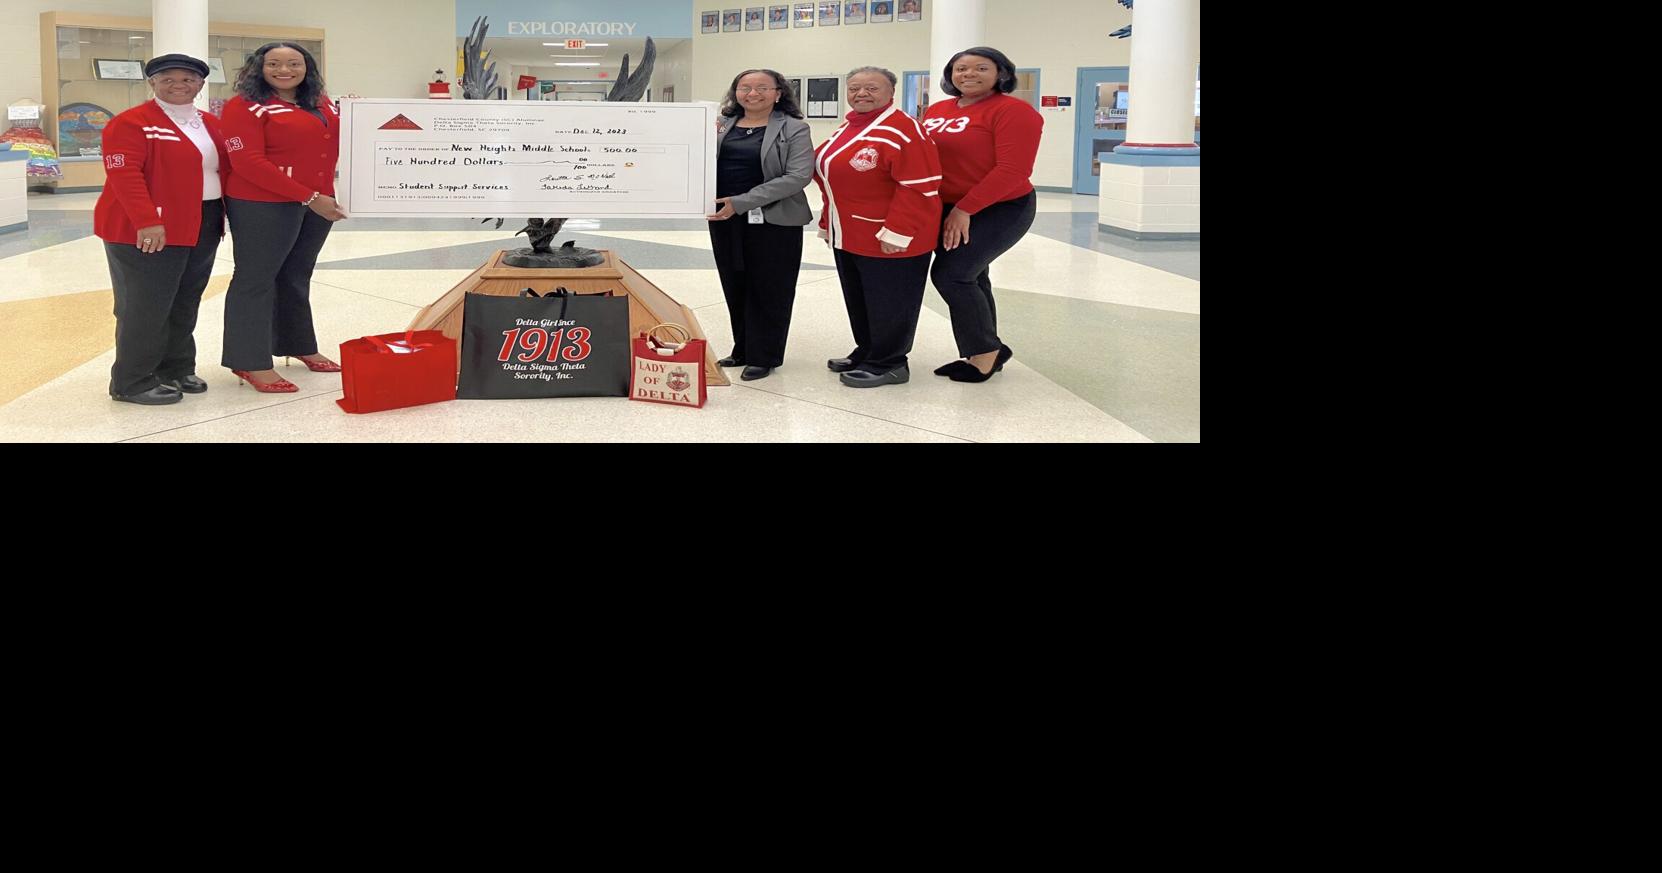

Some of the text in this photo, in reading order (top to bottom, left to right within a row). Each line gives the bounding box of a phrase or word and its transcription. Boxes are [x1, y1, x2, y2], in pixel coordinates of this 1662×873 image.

[507, 21, 637, 35] EXPLORATORY
[567, 40, 582, 48] EXIT
[225, 136, 244, 152] 13
[451, 143, 472, 151] New
[480, 144, 516, 154] Heights
[522, 144, 554, 152] Middle
[105, 154, 124, 168] 13
[385, 157, 504, 165] Five Hundred Dollars
[515, 318, 539, 326] Delta
[540, 319, 558, 328] Girl
[498, 327, 592, 362] 1913
[502, 363, 527, 371] Delta
[529, 363, 559, 372] Sigma
[639, 361, 666, 374] LADY
[513, 371, 554, 382] Sorority,
[643, 376, 660, 385] OF
[638, 388, 691, 403] DELTA
